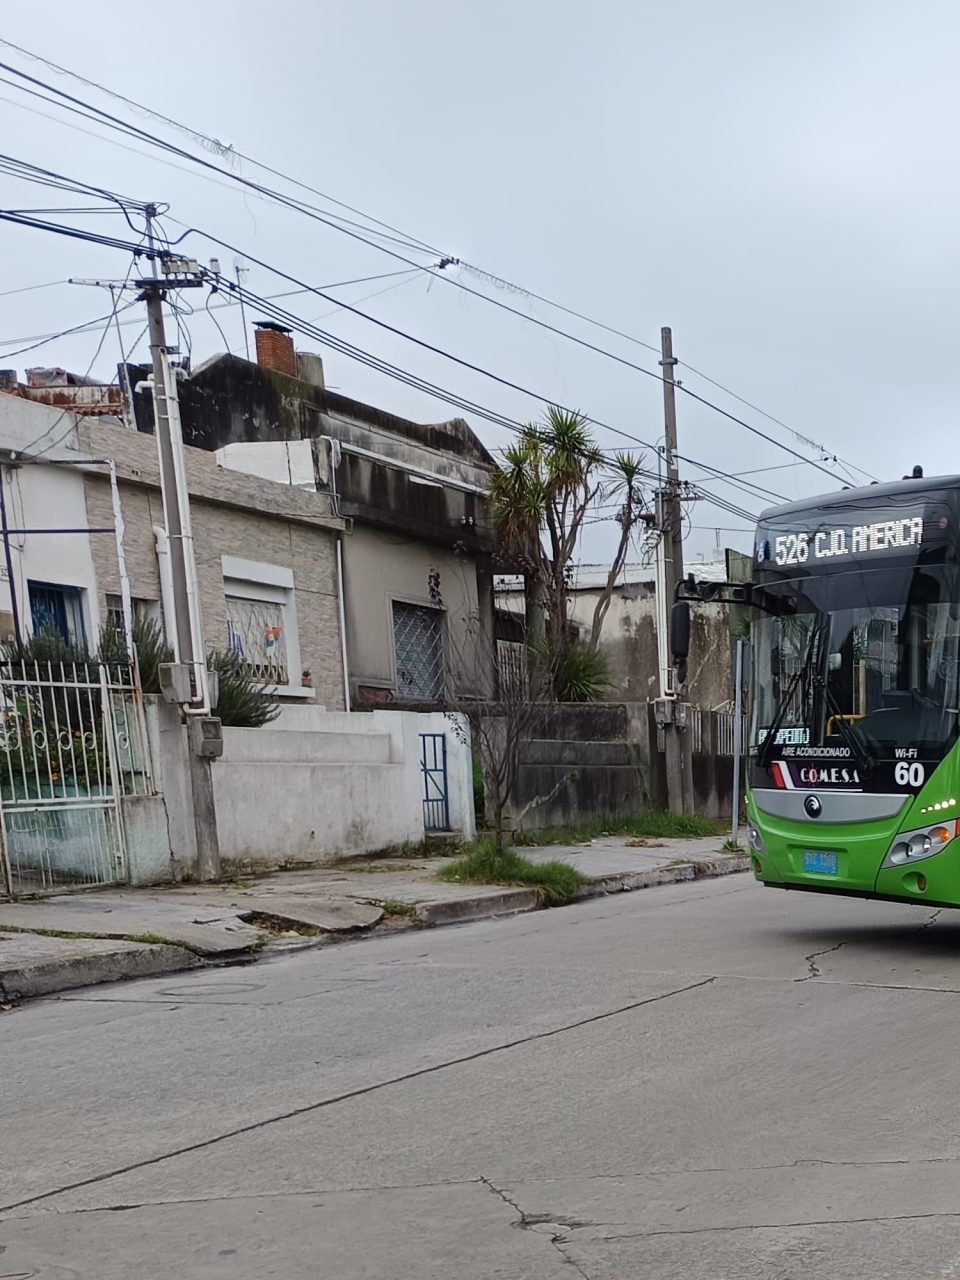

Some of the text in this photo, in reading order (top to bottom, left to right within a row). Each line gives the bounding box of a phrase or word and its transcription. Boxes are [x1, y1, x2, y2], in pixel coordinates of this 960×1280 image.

[775, 533, 809, 565] 526
[851, 517, 923, 552] AMERICA
[782, 746, 851, 758] AIRE ACONDICIONADO
[894, 748, 918, 759] Wi-Fi
[894, 761, 925, 787] 60
